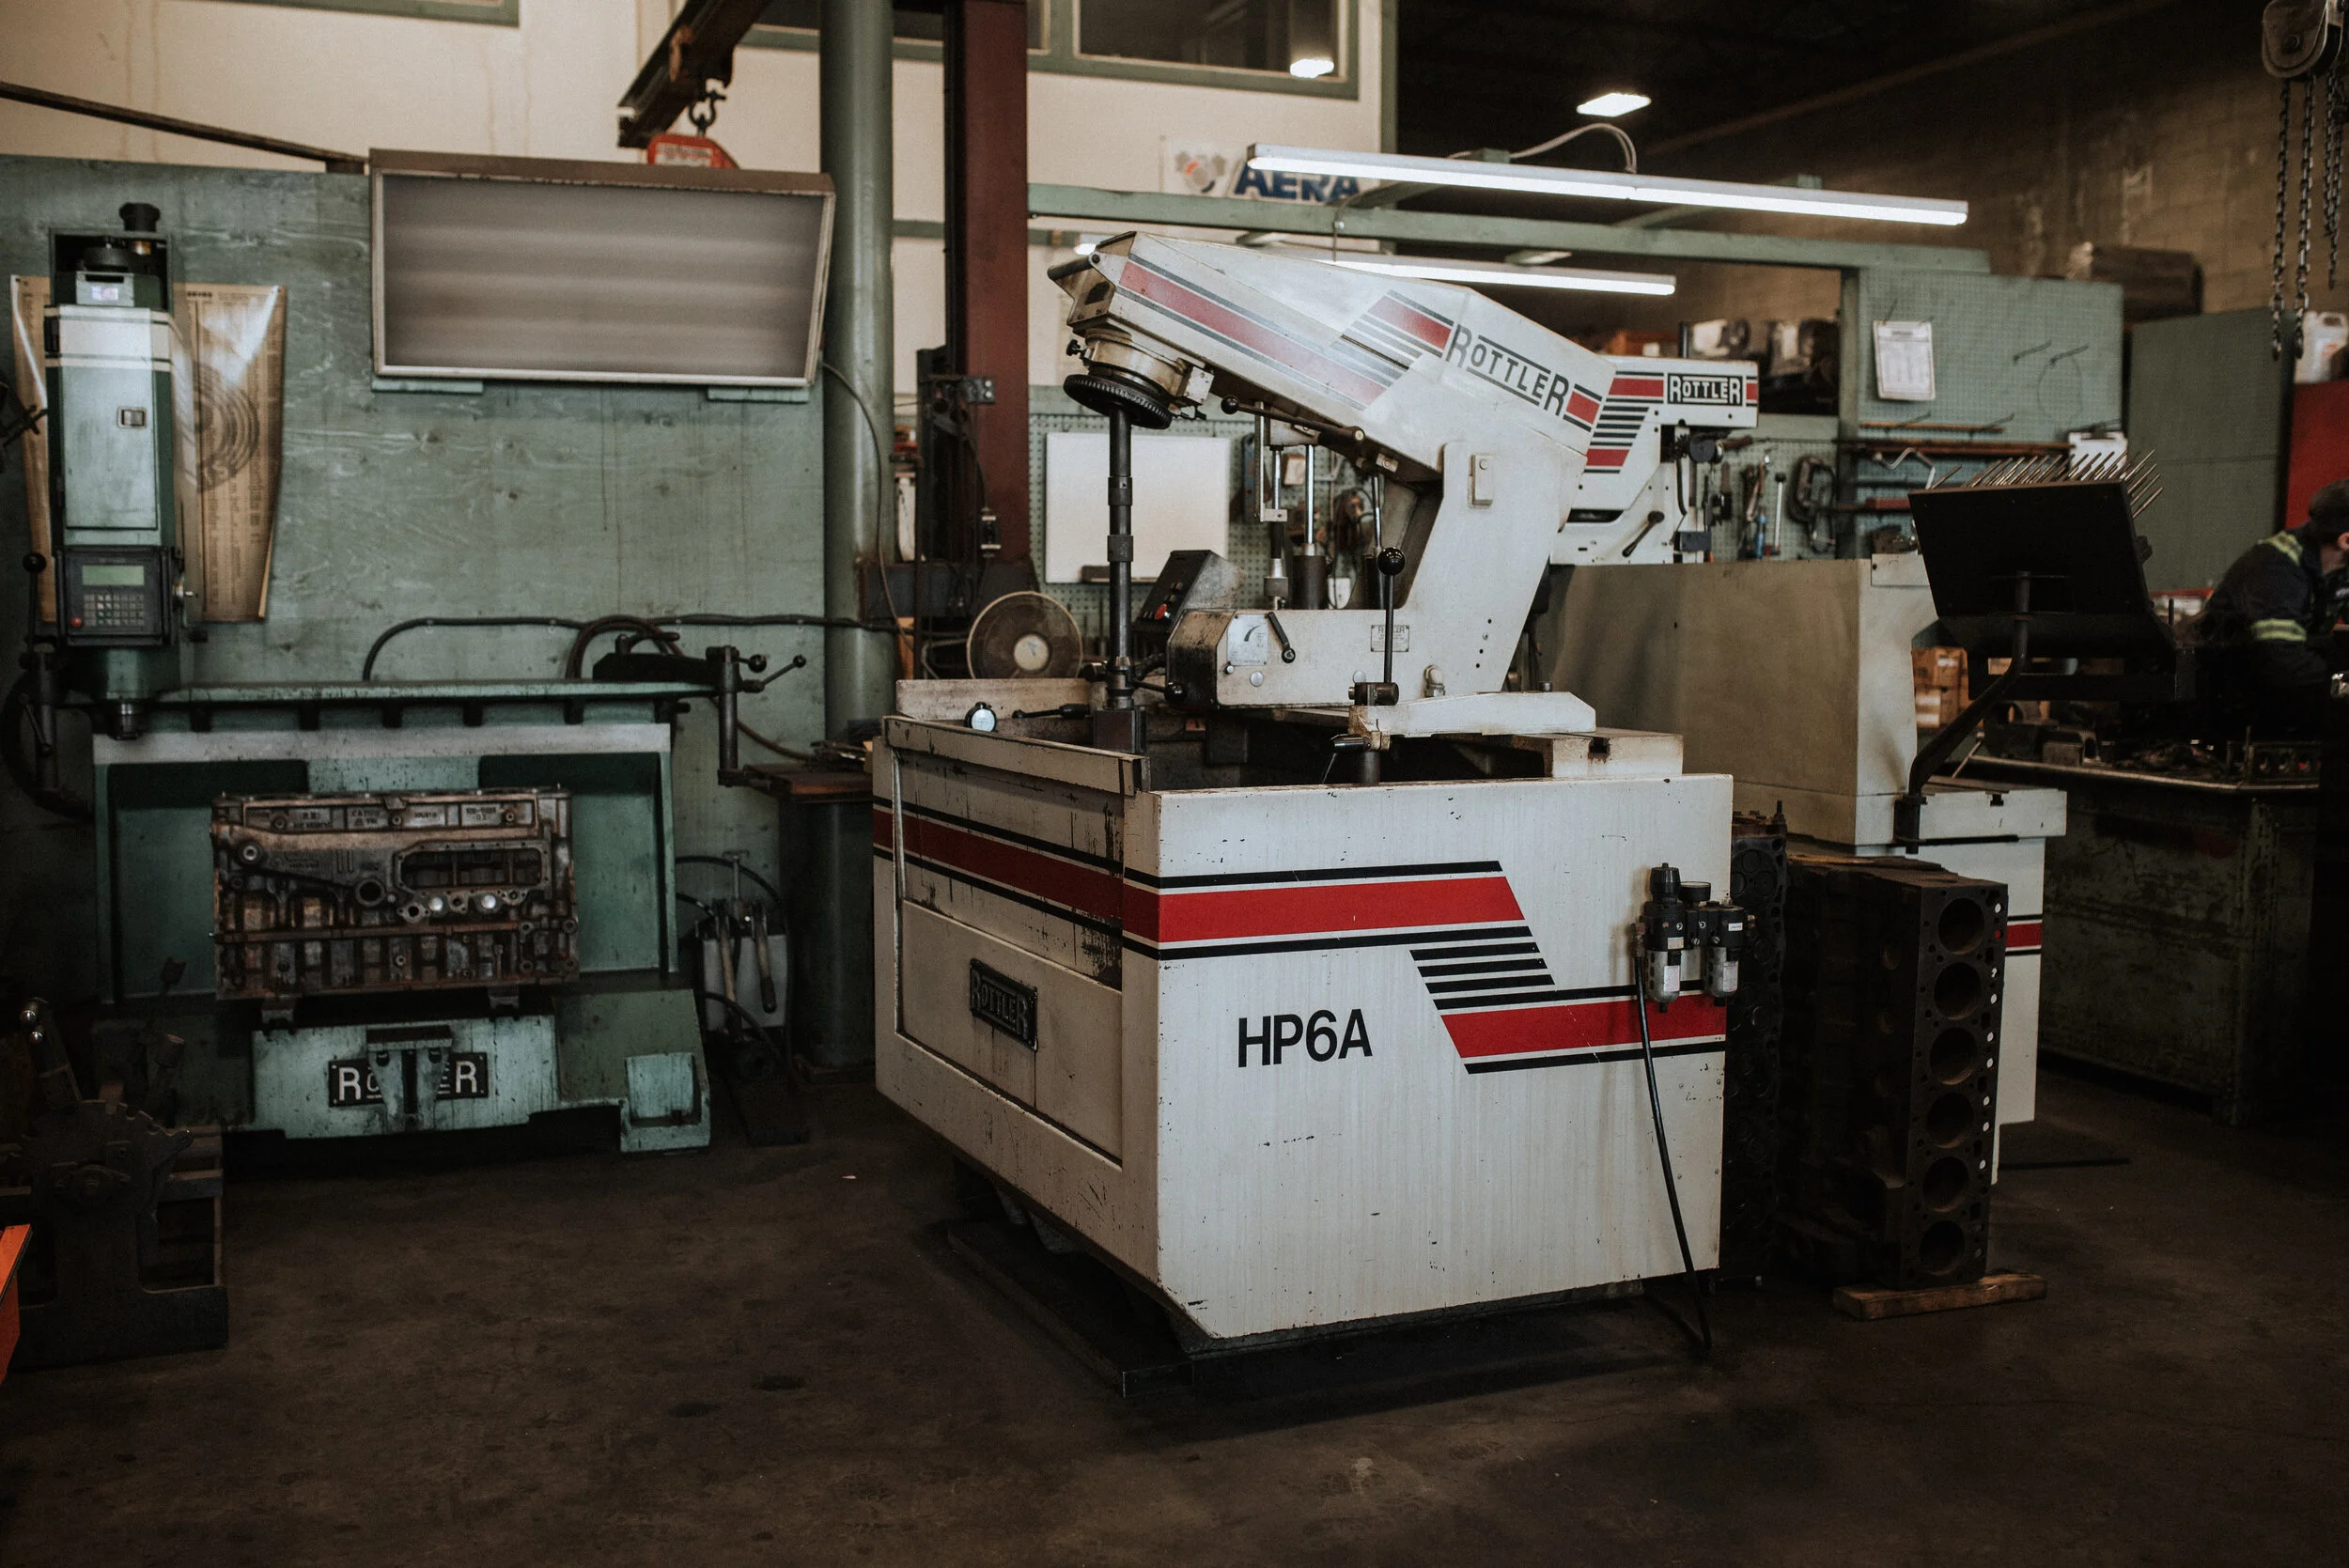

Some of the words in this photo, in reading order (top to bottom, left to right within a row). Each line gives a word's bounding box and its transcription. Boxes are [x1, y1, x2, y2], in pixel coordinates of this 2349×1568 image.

[1445, 324, 1570, 416] ROTTLER
[1669, 375, 1741, 405] ROTTLER
[972, 969, 1028, 1040] ROTTLER
[1238, 1008, 1373, 1067] HP6A
